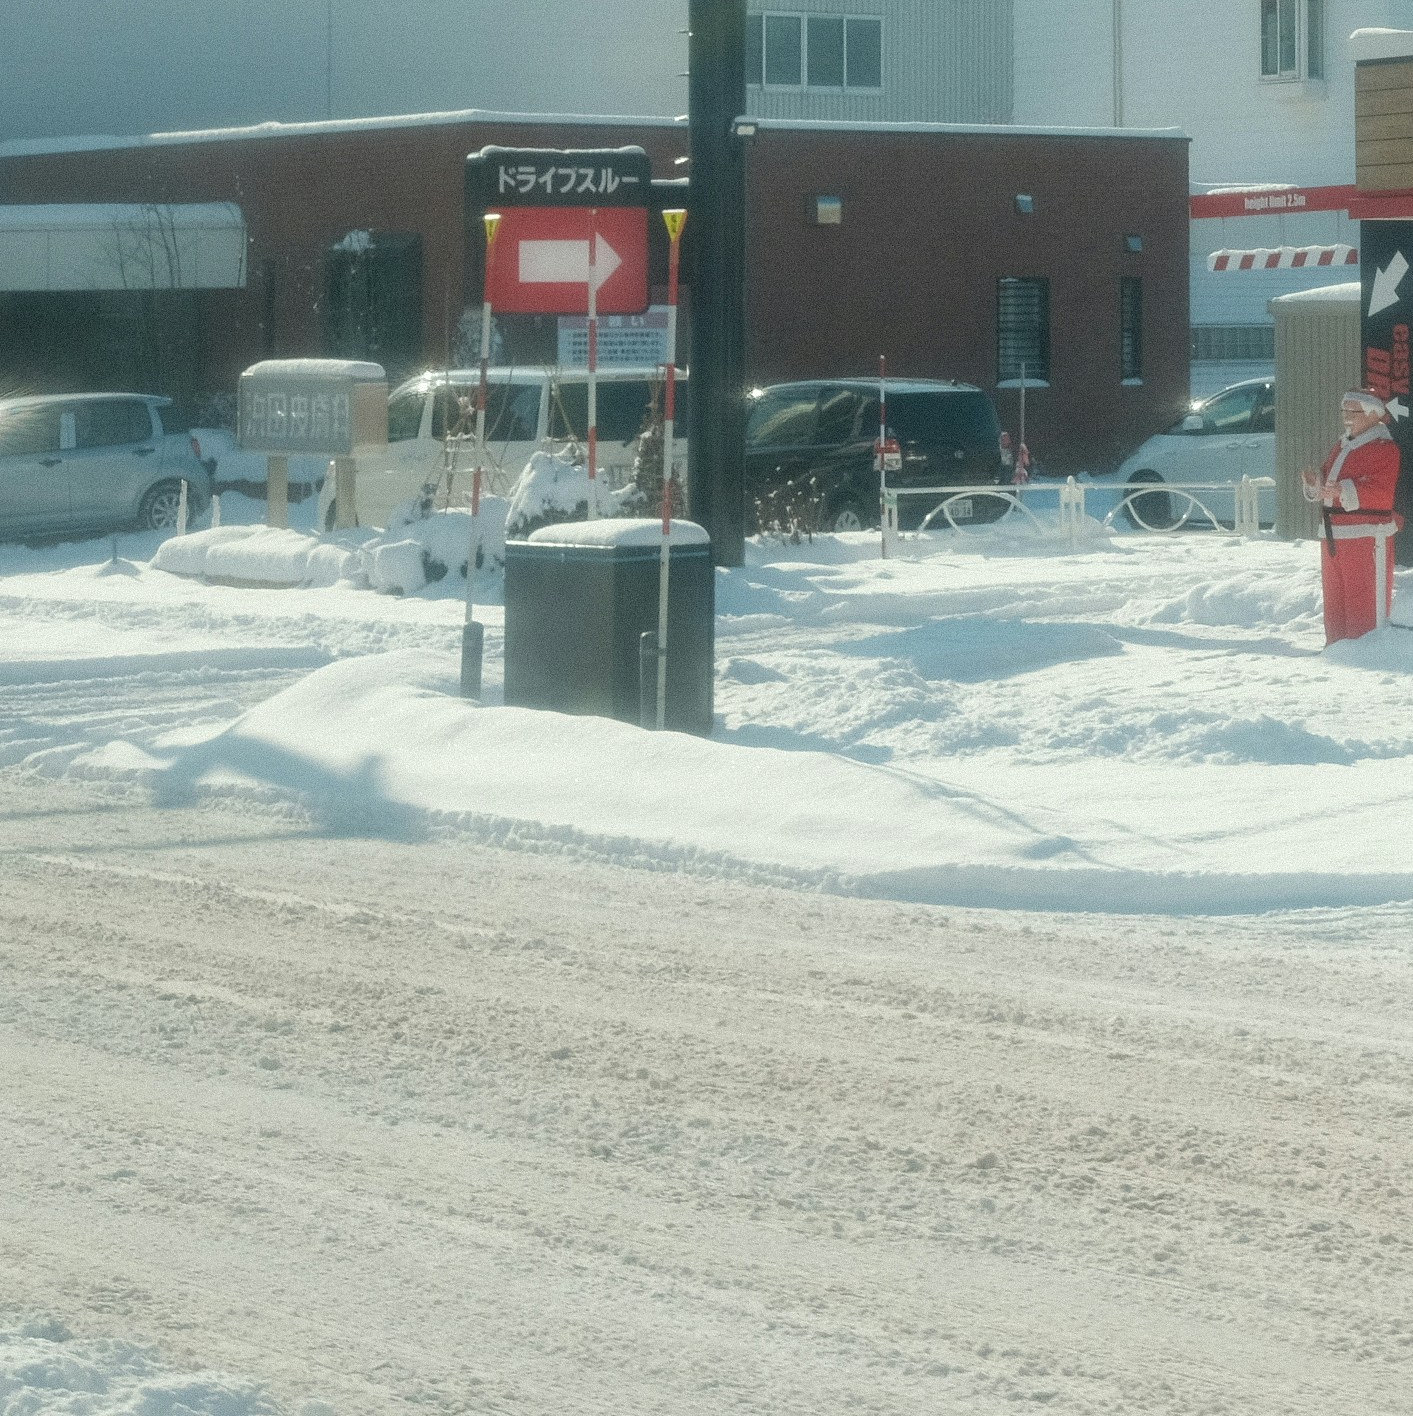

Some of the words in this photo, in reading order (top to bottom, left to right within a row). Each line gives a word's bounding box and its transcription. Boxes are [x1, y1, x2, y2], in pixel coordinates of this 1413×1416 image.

[498, 166, 640, 194] ドライブスルー
